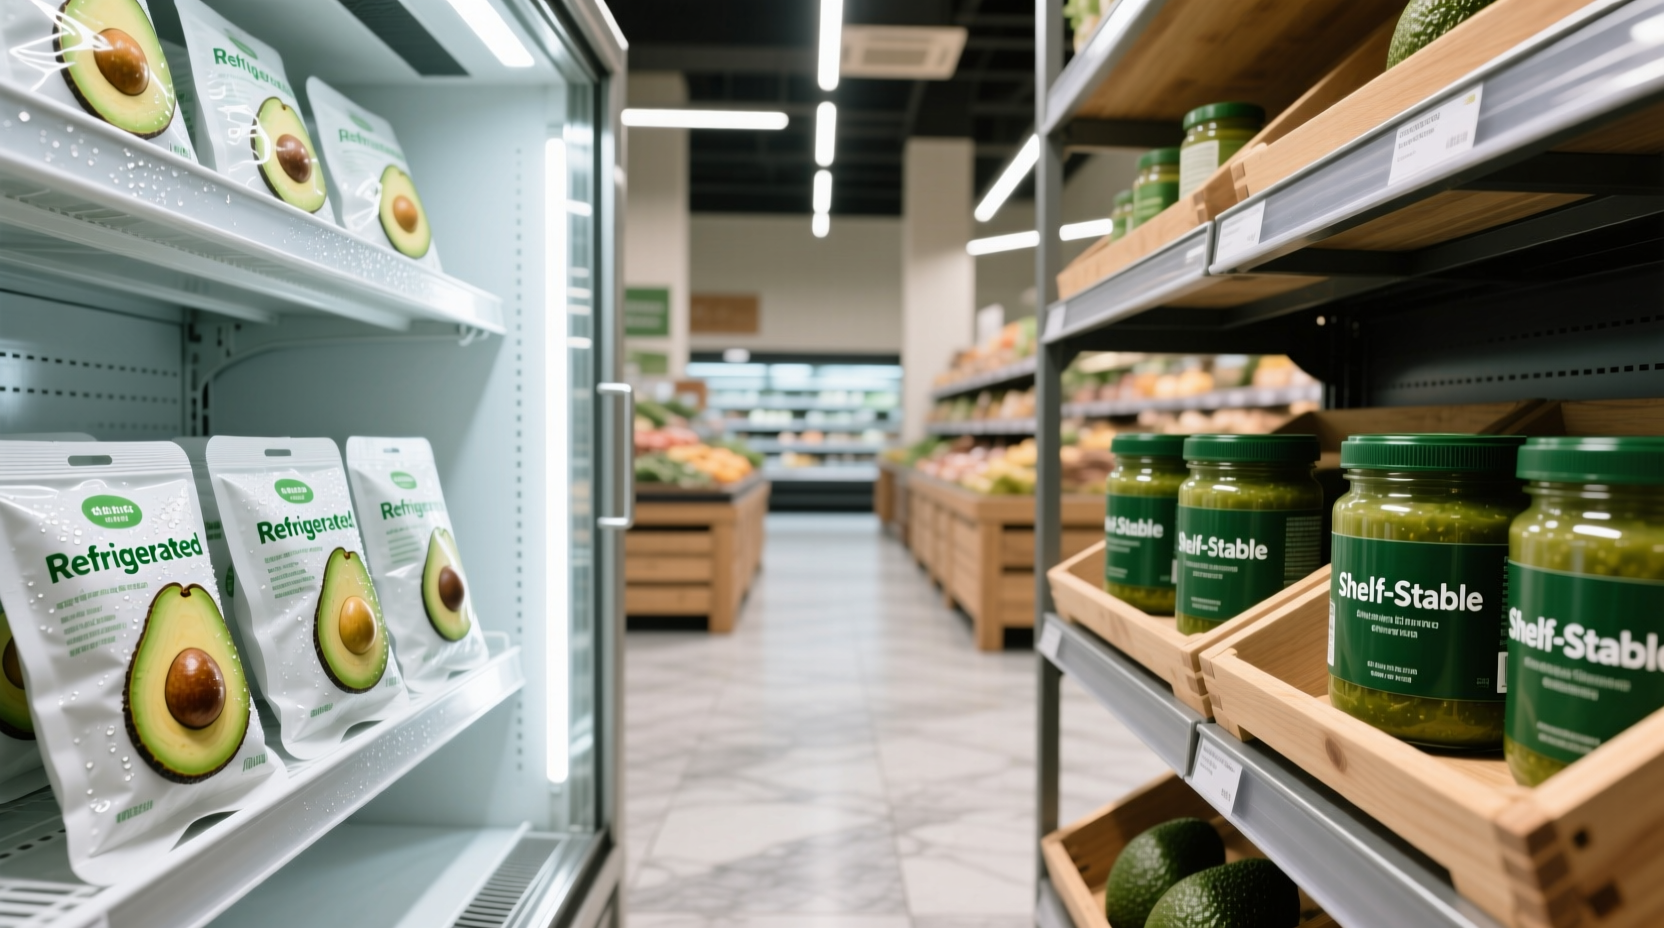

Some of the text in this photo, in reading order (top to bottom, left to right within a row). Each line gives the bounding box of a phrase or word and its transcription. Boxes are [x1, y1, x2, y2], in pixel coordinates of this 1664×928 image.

[257, 510, 354, 544] Refrigerated
[46, 532, 203, 584] Refrigerated
[1338, 571, 1484, 612] Shelf-Stable
